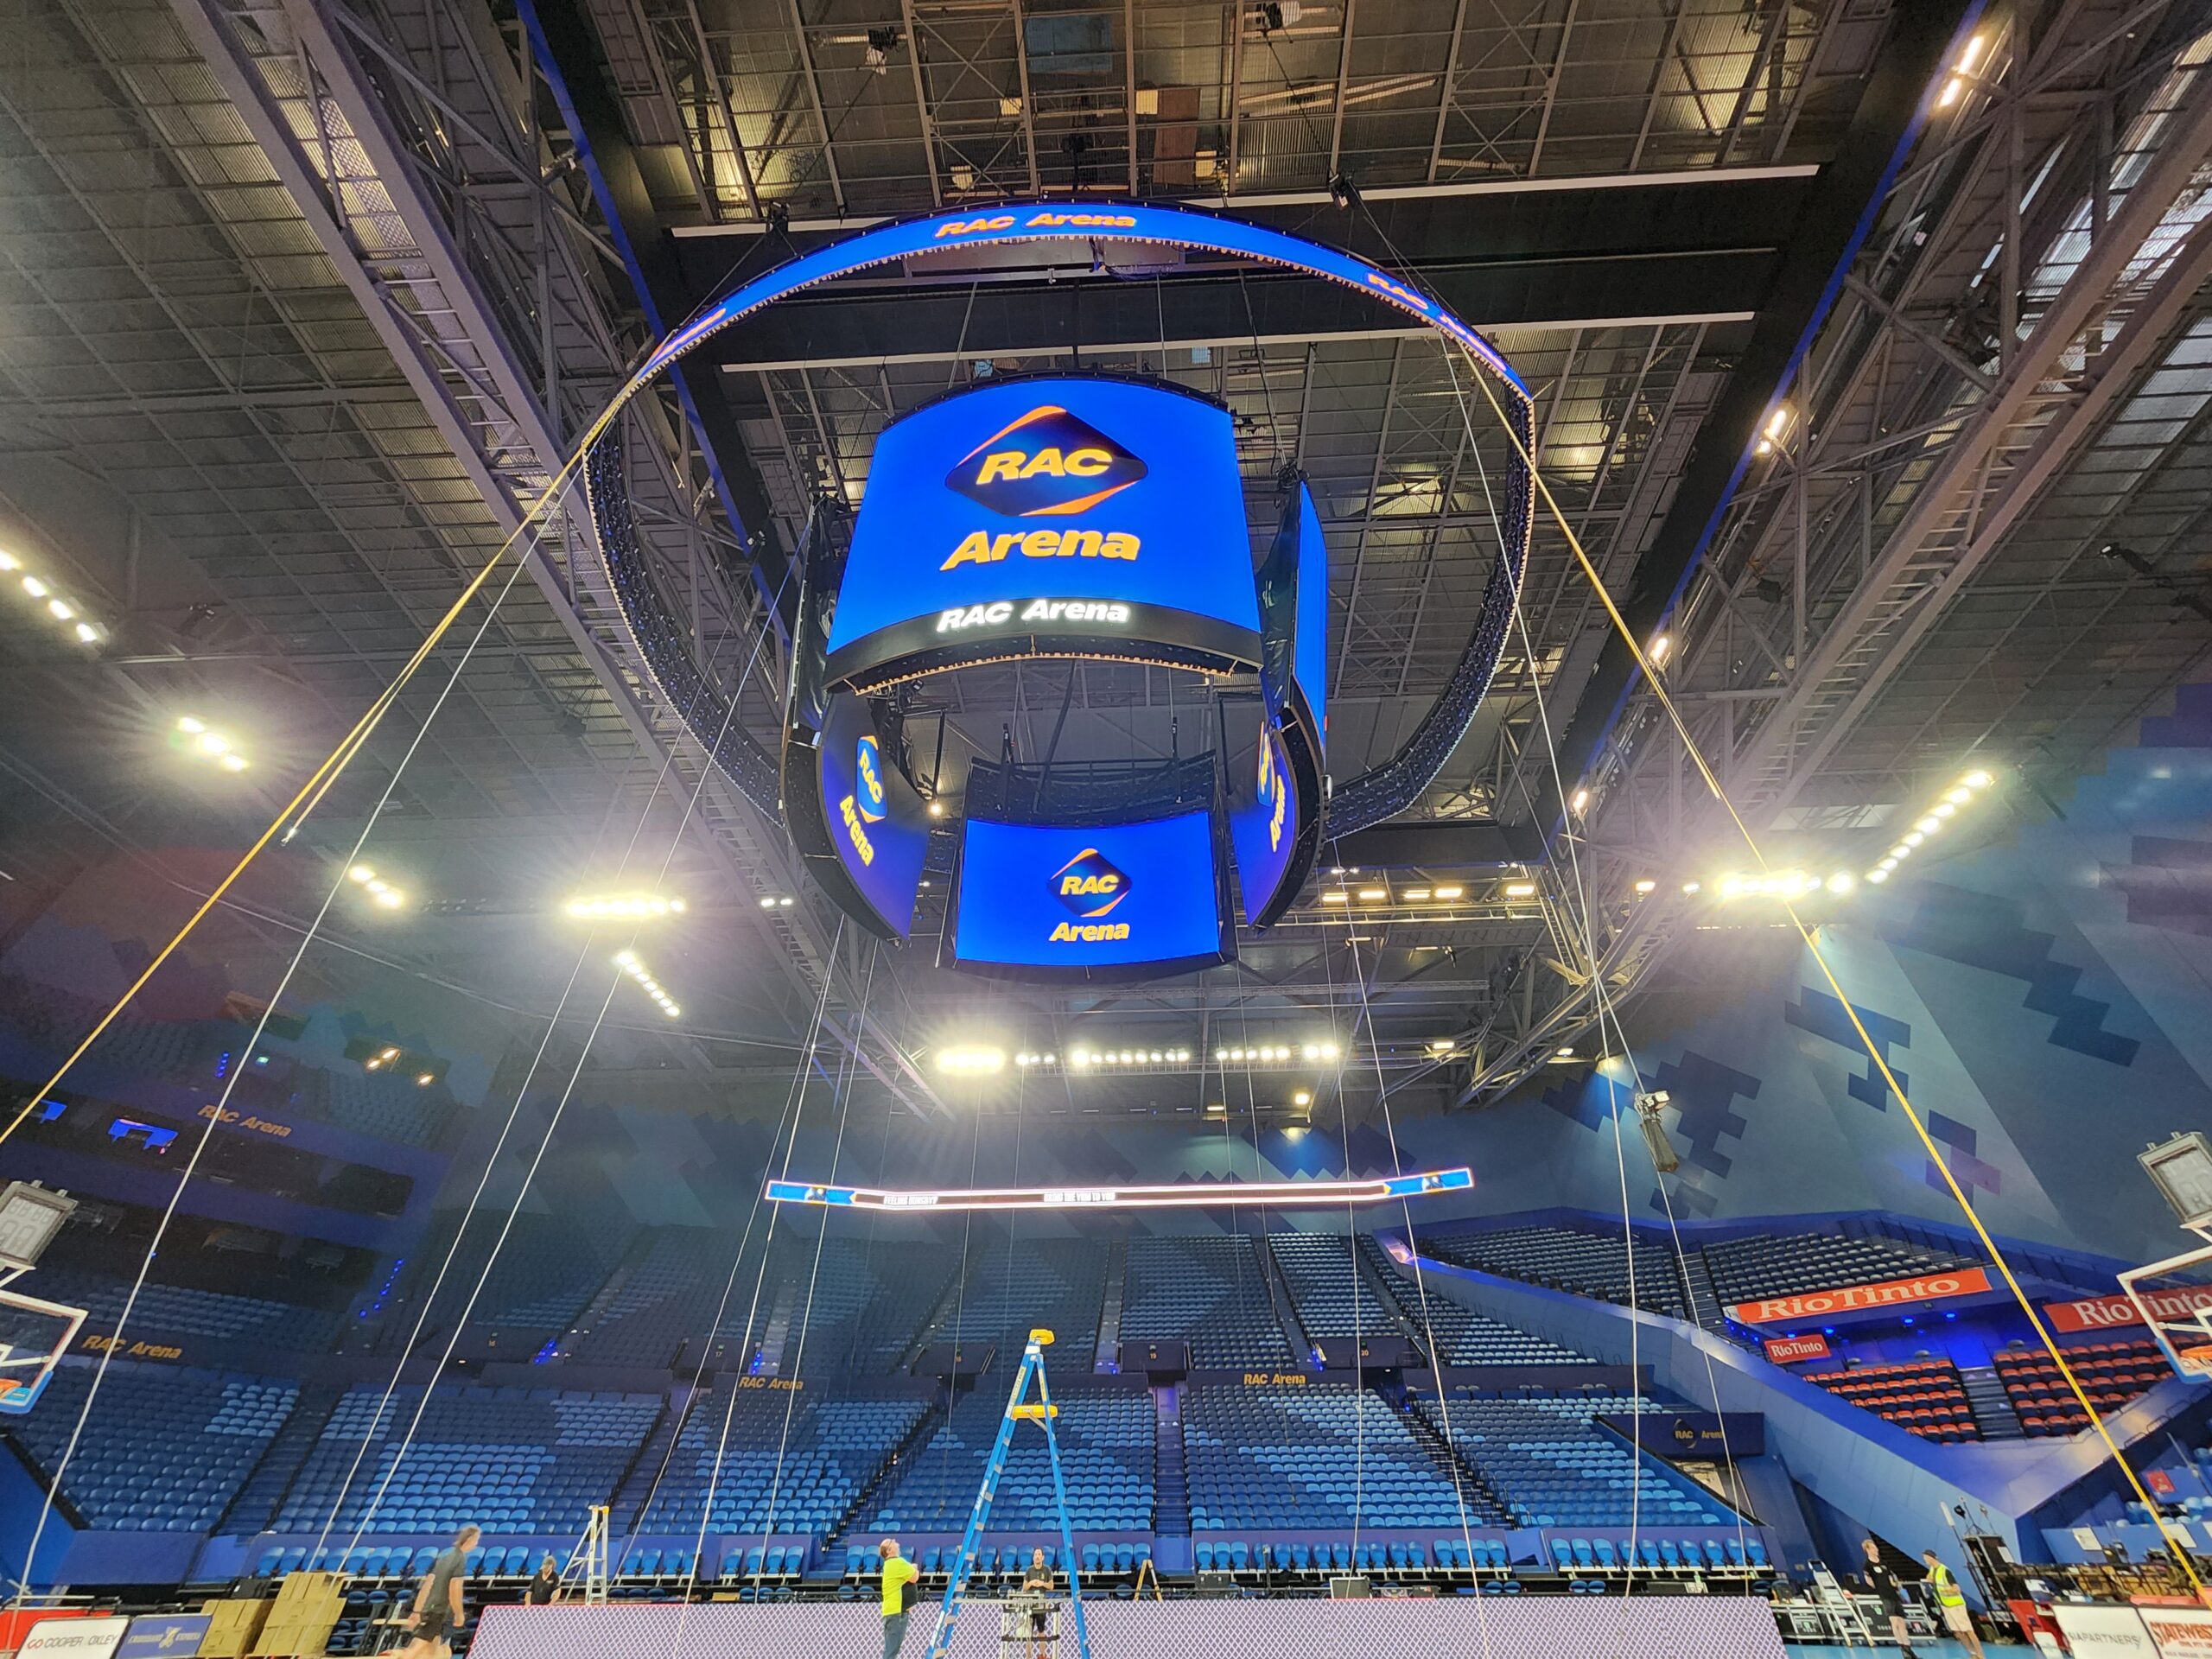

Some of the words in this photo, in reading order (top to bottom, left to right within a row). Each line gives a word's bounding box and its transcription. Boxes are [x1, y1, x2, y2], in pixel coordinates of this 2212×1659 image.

[936, 216, 1015, 238] RAC
[1026, 213, 1137, 227] Arena
[976, 448, 1113, 486] RAC
[939, 530, 1141, 571] Arena
[937, 602, 1014, 632] RAC
[1021, 600, 1130, 623] Arena
[860, 748, 883, 804] RAC
[839, 794, 875, 868] Arena
[1059, 874, 1120, 896] RAC
[1048, 921, 1130, 943] Arena
[197, 1104, 240, 1123] RAC
[238, 1116, 292, 1138] Arena
[82, 1335, 127, 1352] RAC
[127, 1341, 182, 1359] Arena
[739, 1376, 766, 1389] RAC
[767, 1378, 804, 1390] Arena
[1243, 1373, 1268, 1384] RAC
[1272, 1374, 1306, 1385] Arena
[1675, 1430, 1694, 1440] RAC
